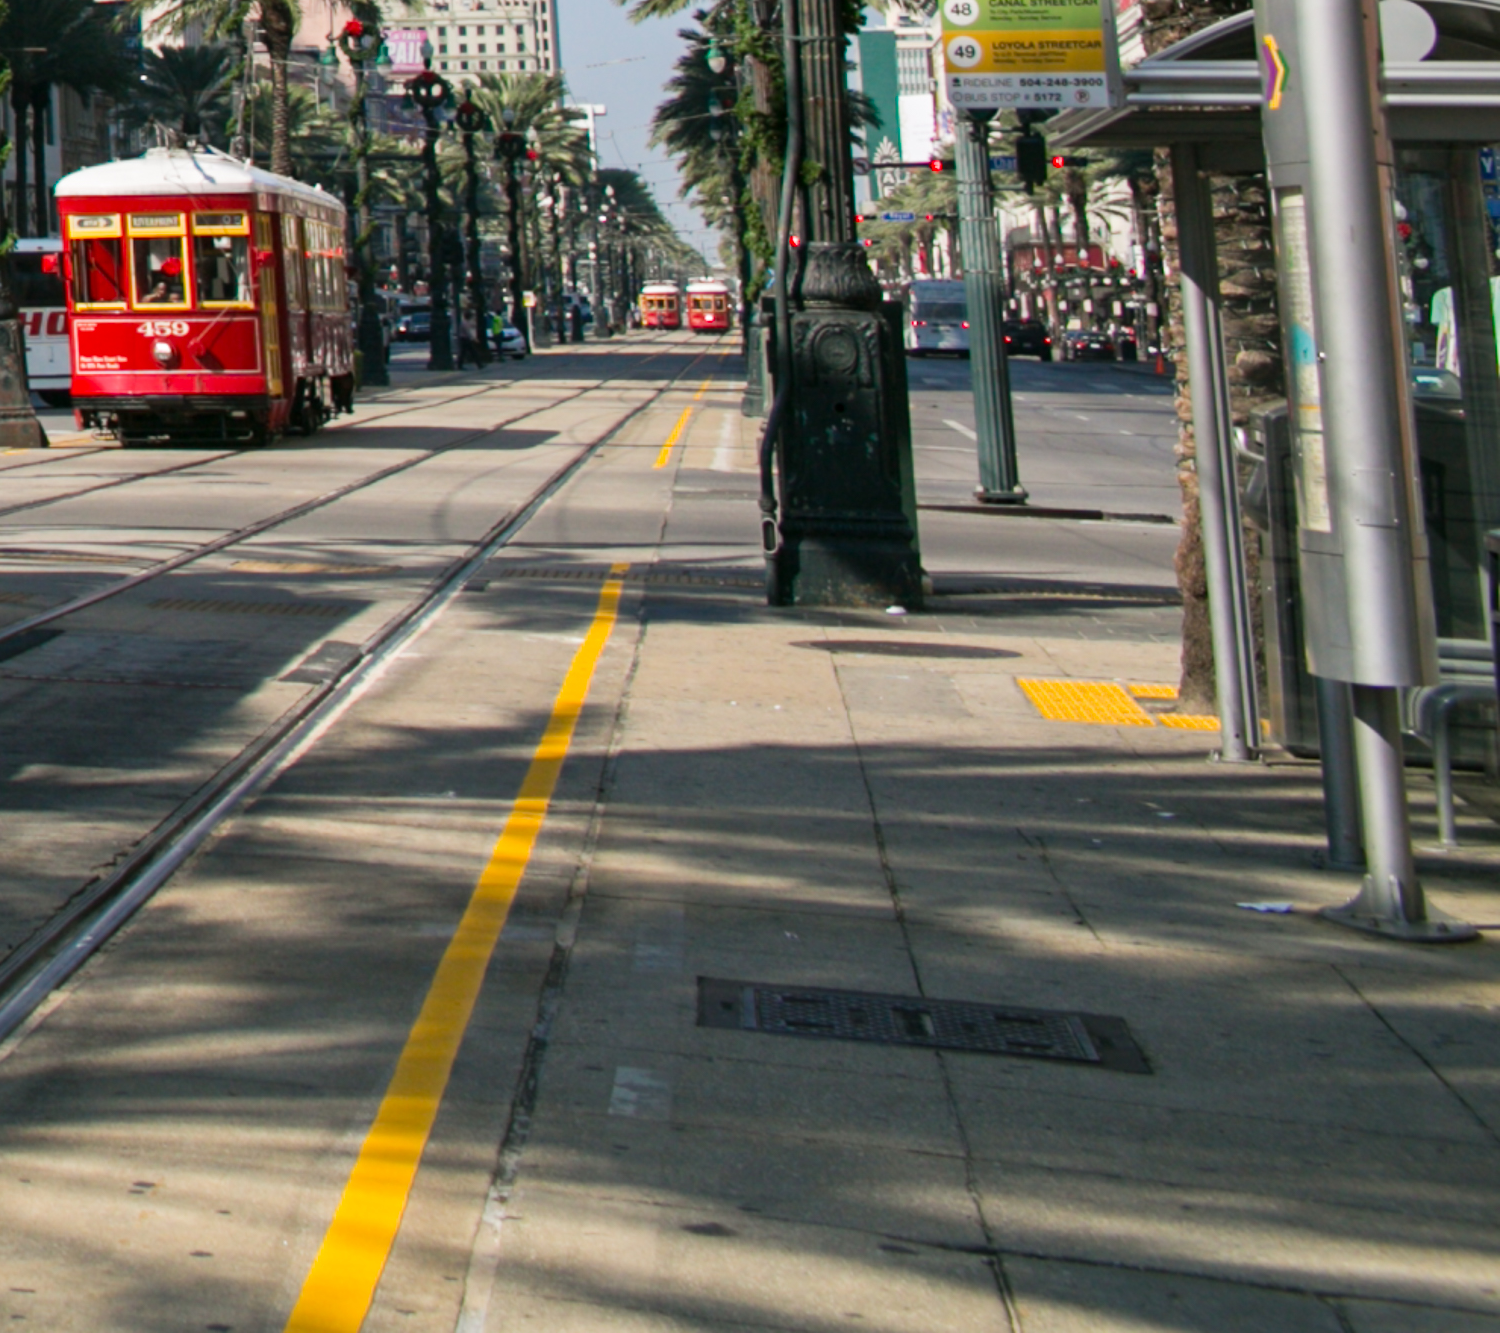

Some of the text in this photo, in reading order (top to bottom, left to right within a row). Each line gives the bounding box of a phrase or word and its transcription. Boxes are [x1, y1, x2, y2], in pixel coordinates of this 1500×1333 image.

[950, 3, 972, 16] 48
[954, 45, 976, 58] 49
[992, 39, 1102, 51] LOYOLA STREETCAR
[965, 92, 988, 103] BUS
[990, 92, 1021, 102] STOP
[1033, 92, 1062, 102] 5172
[136, 321, 190, 338] 459
